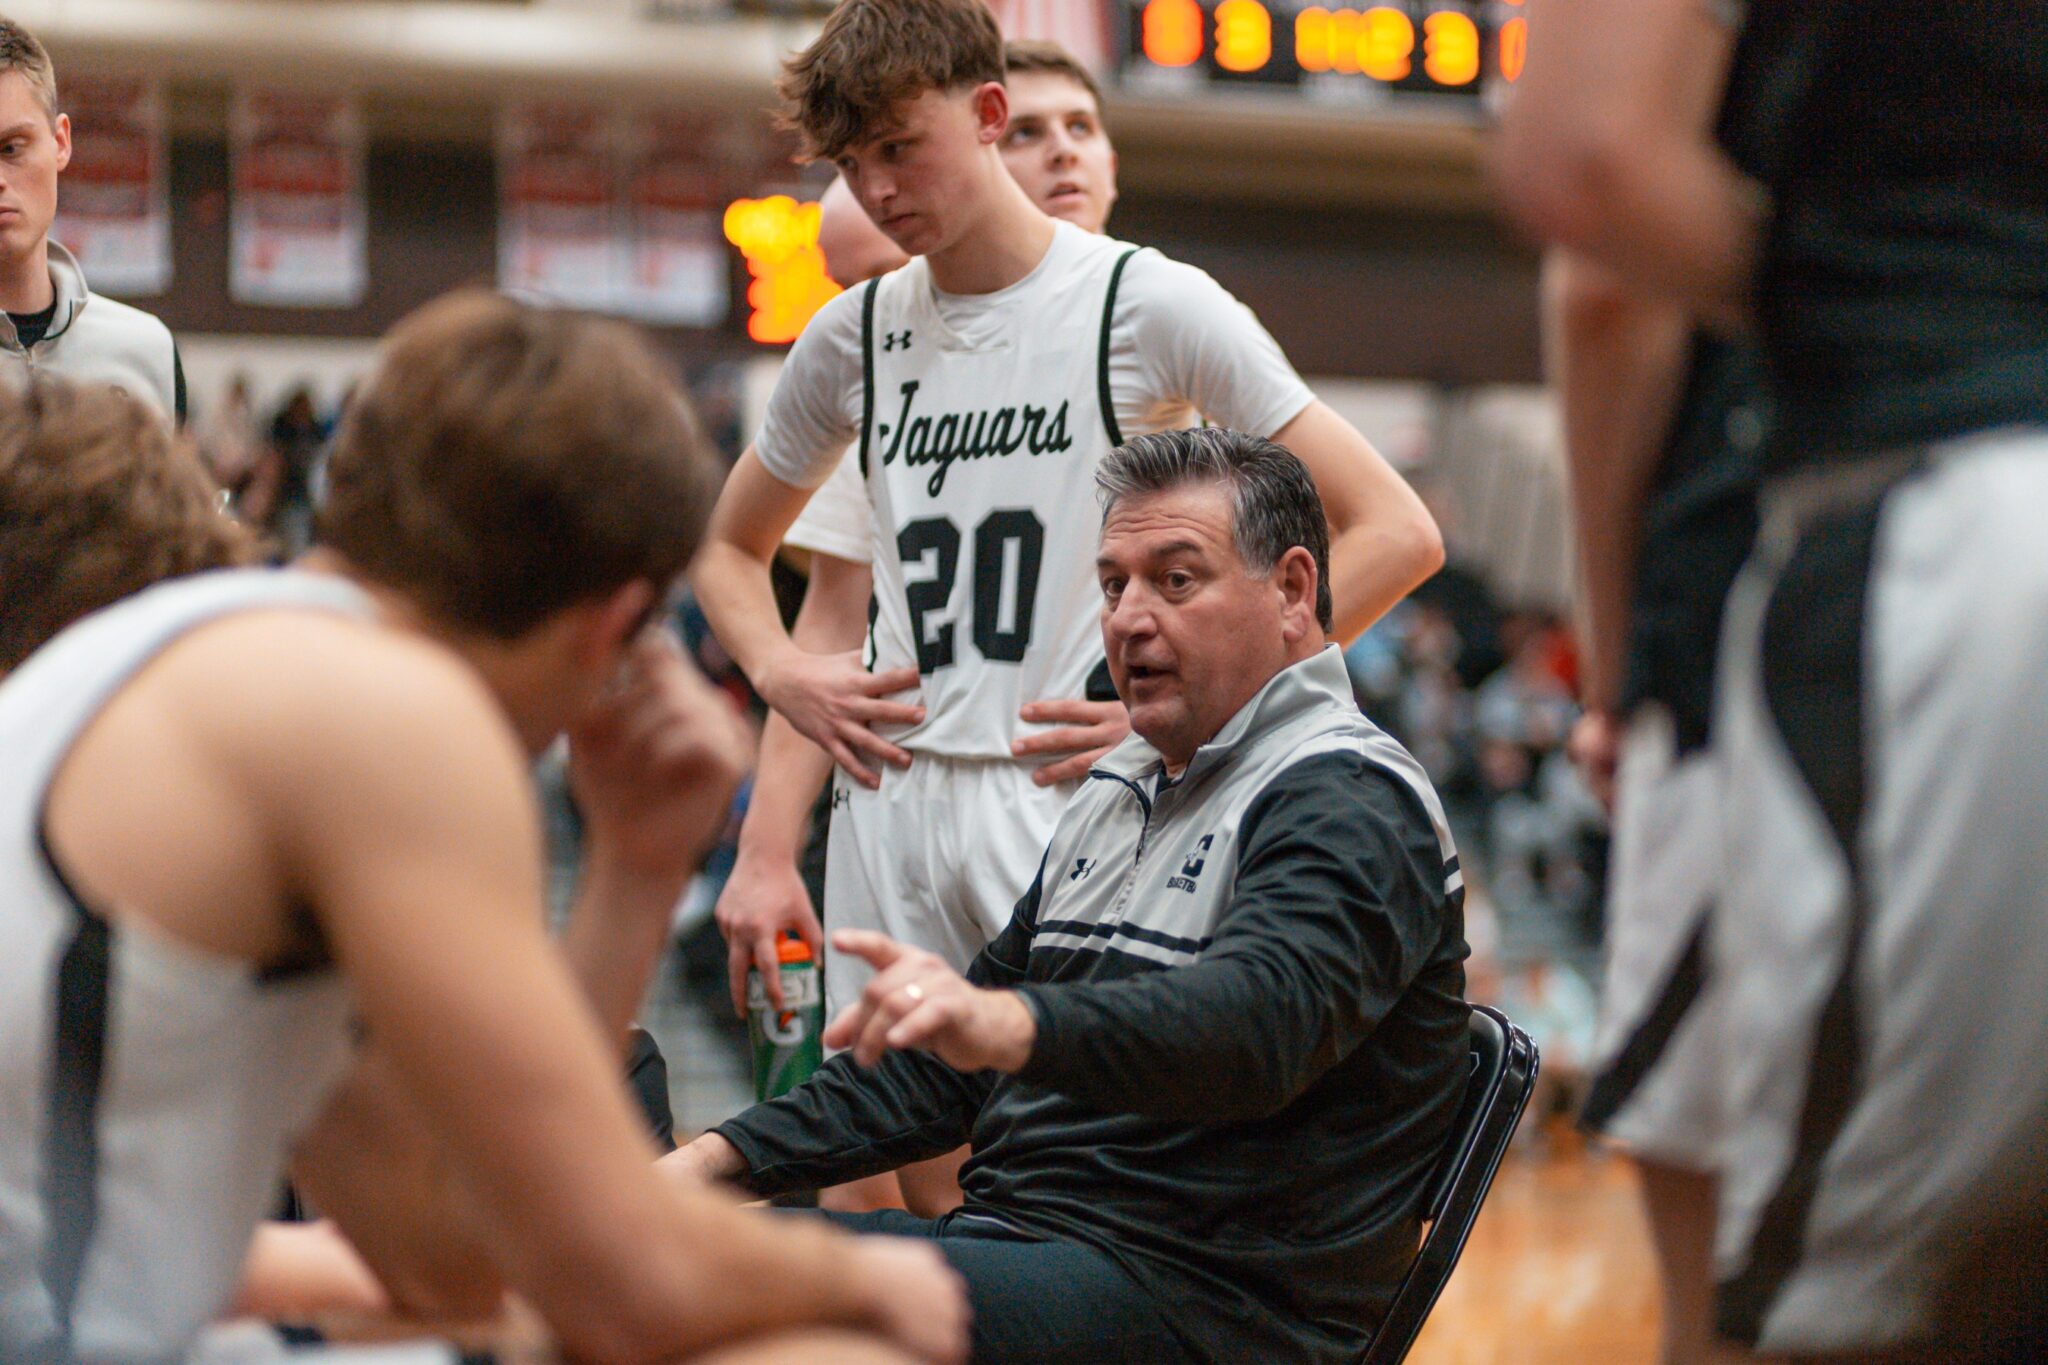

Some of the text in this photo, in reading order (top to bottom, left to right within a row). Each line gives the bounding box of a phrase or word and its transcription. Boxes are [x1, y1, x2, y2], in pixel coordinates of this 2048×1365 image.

[879, 380, 1073, 498] Jaguars
[897, 508, 1044, 674] 20
[762, 1006, 804, 1045] G
